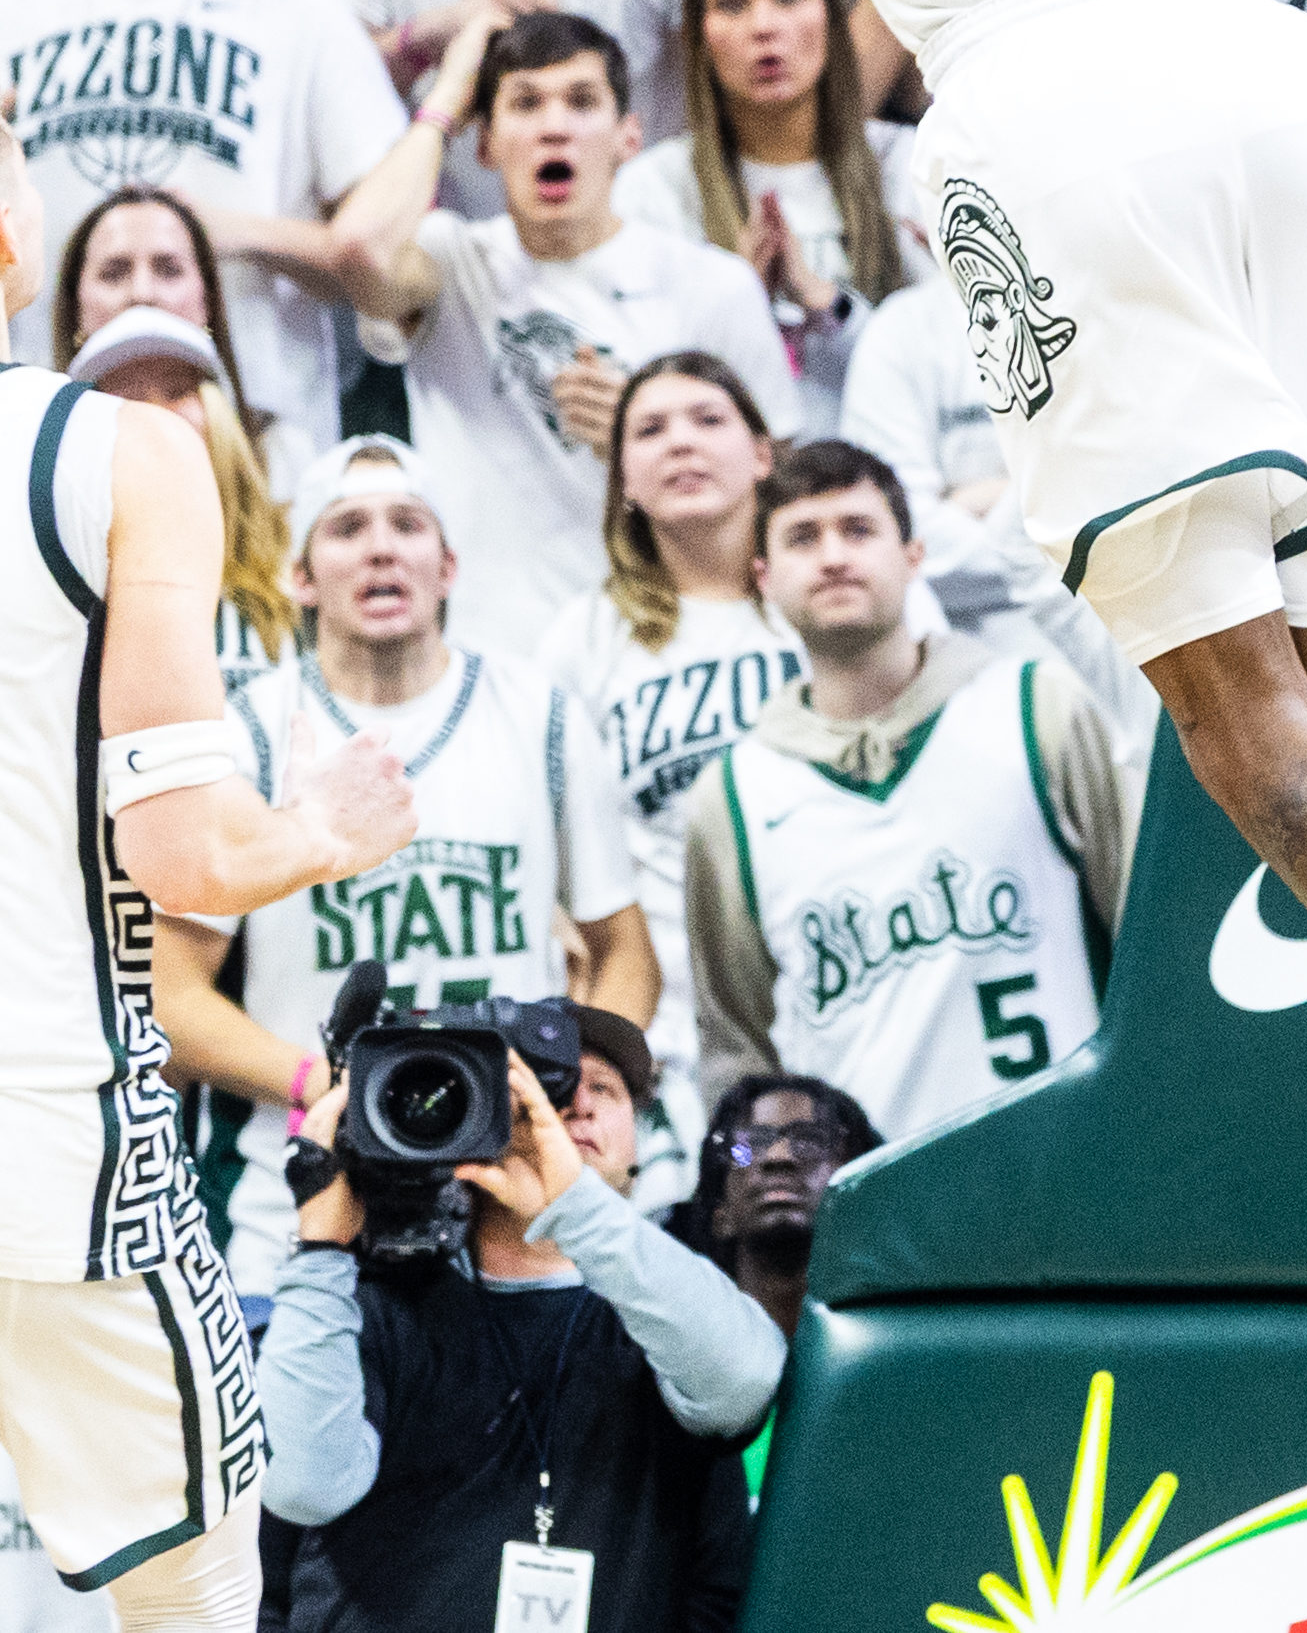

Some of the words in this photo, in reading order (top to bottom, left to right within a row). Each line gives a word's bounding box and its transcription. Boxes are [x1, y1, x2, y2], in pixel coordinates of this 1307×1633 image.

[310, 843, 528, 971] STATE
[798, 858, 1032, 1014] State
[976, 972, 1051, 1082] 5
[517, 1592, 575, 1626] TV
